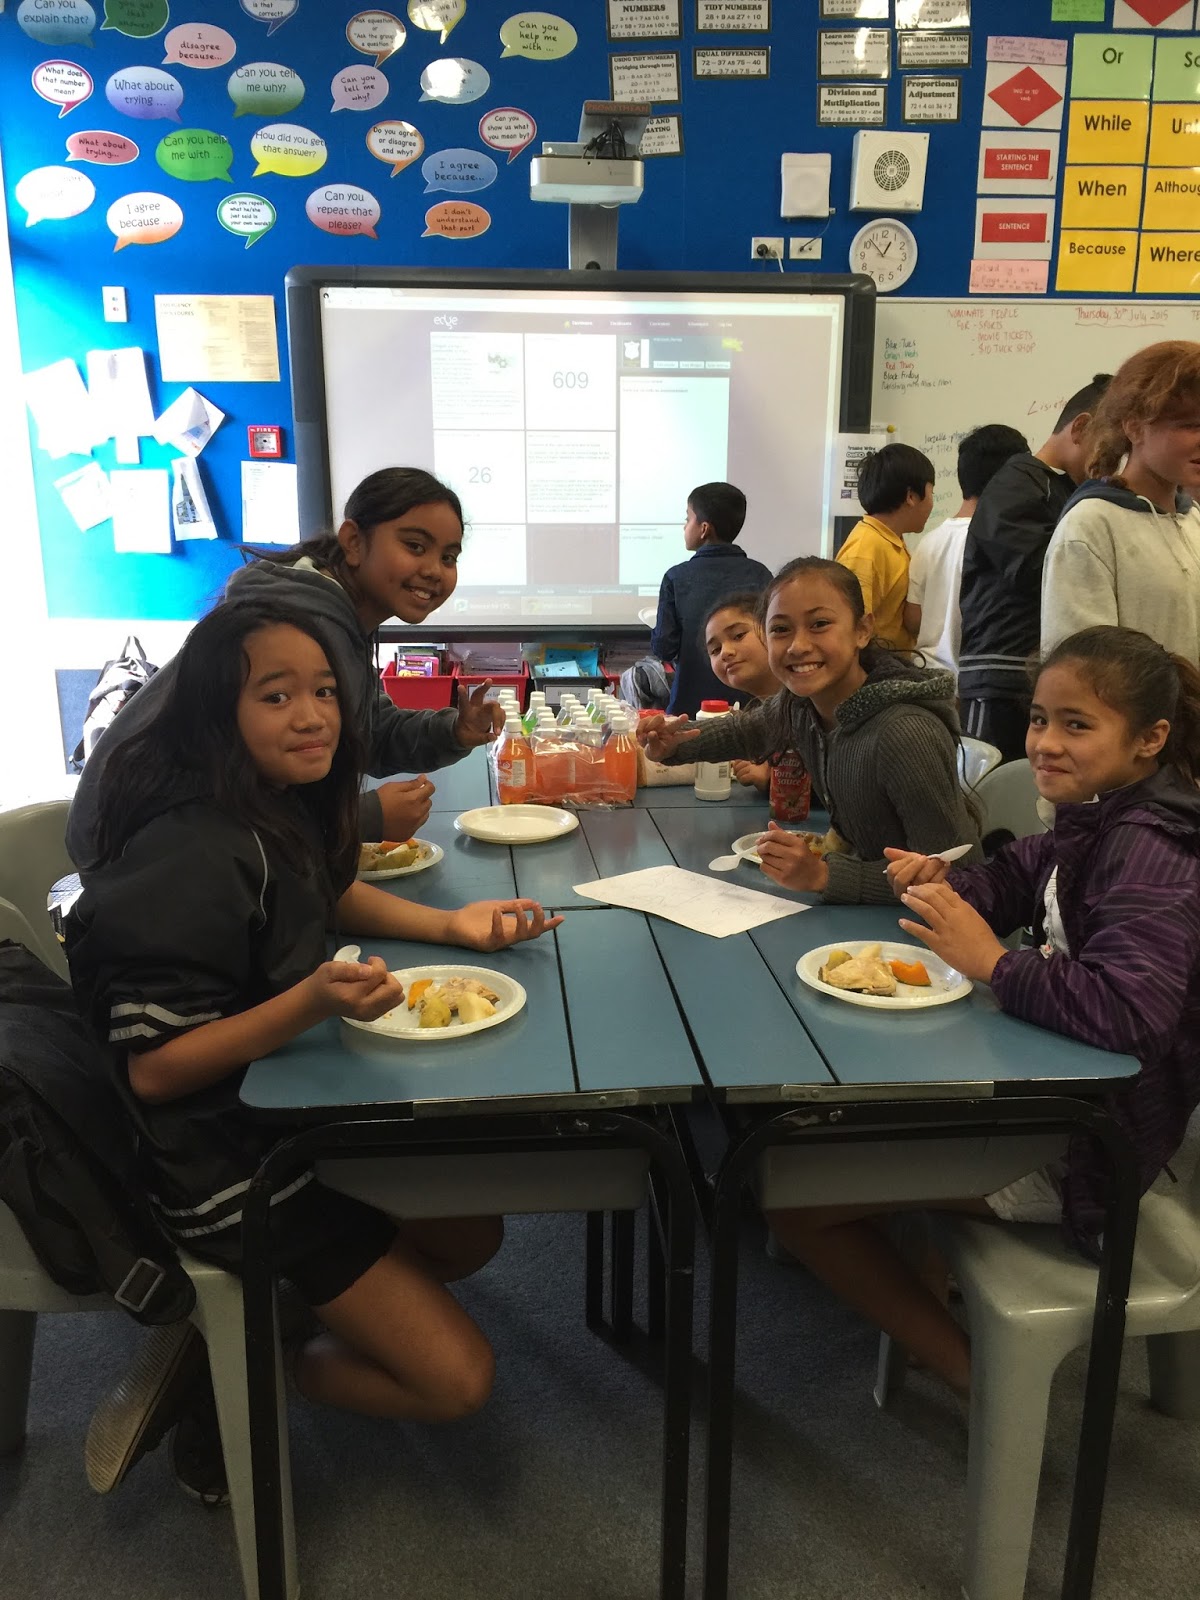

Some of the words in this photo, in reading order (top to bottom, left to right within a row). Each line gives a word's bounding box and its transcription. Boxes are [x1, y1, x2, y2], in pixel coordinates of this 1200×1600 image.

[58, 0, 76, 9] you
[623, 4, 666, 13] NUMBERS
[23, 14, 59, 23] explain
[62, 14, 89, 24] that?
[519, 21, 537, 29] Can
[542, 24, 559, 33] you
[520, 31, 539, 41] help
[180, 41, 220, 51] disagree
[522, 43, 542, 51] with
[179, 51, 222, 60] because...
[1102, 47, 1124, 64] Or
[44, 66, 64, 75] What
[67, 69, 83, 77] does
[236, 69, 256, 78] Can
[259, 69, 276, 80] you
[60, 78, 85, 87] number
[340, 76, 357, 84] Can
[361, 75, 376, 84] you
[907, 80, 958, 89] Proportional
[114, 79, 141, 90] What
[144, 80, 174, 91] about
[247, 84, 260, 92] me
[263, 83, 287, 93] why?
[344, 85, 359, 93] tell
[352, 92, 370, 101] why?
[827, 88, 860, 96] Division
[908, 91, 955, 99] Adjustment
[124, 96, 153, 106] trying
[1084, 115, 1132, 131] While
[79, 138, 98, 146] What
[102, 141, 127, 149] about
[163, 136, 183, 147] Can
[186, 137, 204, 147] you
[255, 131, 275, 141] How
[277, 132, 292, 142] did
[294, 136, 308, 147] you
[311, 137, 326, 147] get
[388, 138, 417, 148] disagree
[171, 151, 186, 160] me
[188, 150, 210, 160] with
[263, 145, 281, 154] that
[284, 148, 317, 158] answer?
[439, 161, 445, 169] I
[449, 163, 479, 172] agree
[1001, 163, 1033, 171] SENTENCE
[434, 171, 485, 181] because...
[1078, 180, 1127, 196] When
[324, 190, 344, 201] Can
[347, 192, 364, 202] you
[134, 202, 160, 213] agree
[317, 205, 349, 215] repeat
[352, 207, 373, 216] that
[120, 217, 160, 229] because
[328, 220, 362, 230] please?
[999, 222, 1030, 230] SENTENCE
[872, 233, 879, 241] 11
[881, 230, 889, 239] 12
[864, 240, 871, 249] 10
[899, 241, 905, 250] 2
[1069, 242, 1127, 255] Because
[860, 251, 866, 260] 9
[901, 252, 907, 261] 3
[861, 262, 867, 271] 8
[897, 264, 903, 272] 4
[878, 273, 885, 282] 6
[888, 271, 894, 280] 5
[1129, 309, 1147, 324] July
[1150, 309, 1169, 320] 2015
[885, 361, 896, 370] Red
[552, 370, 590, 390] 609
[883, 371, 898, 380] Black
[468, 466, 492, 484] 26
